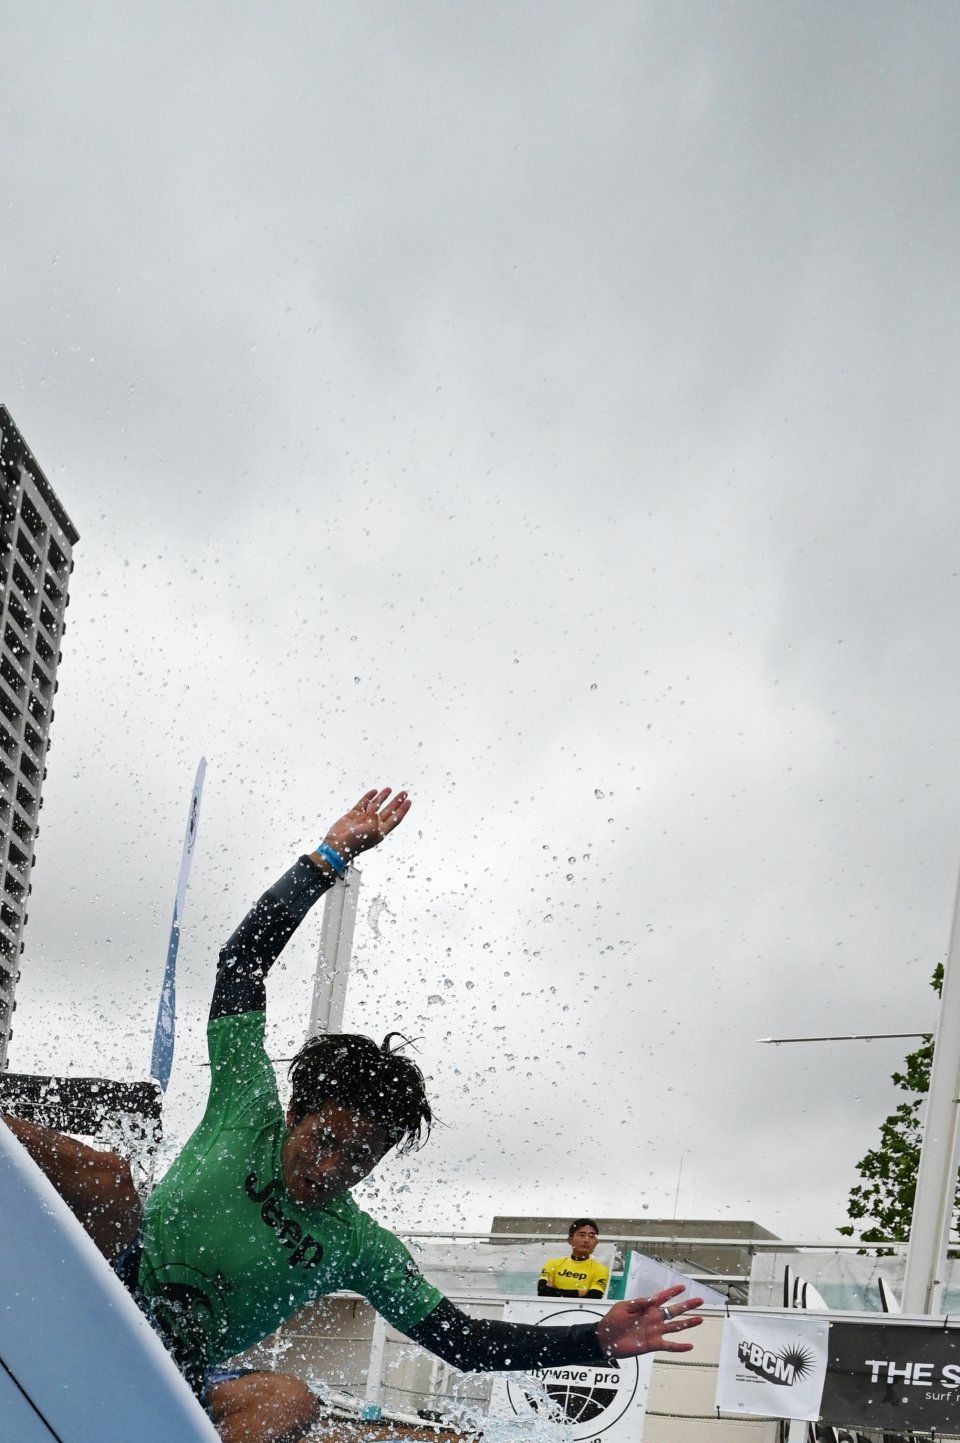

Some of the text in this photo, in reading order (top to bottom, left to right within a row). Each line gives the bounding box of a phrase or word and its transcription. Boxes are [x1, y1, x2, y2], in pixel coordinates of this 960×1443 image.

[244, 1170, 324, 1269] Jeep
[557, 1269, 587, 1280] Jeep
[529, 1368, 620, 1386] itywave pro
[865, 1360, 935, 1387] THE
[925, 1391, 952, 1402] surf
